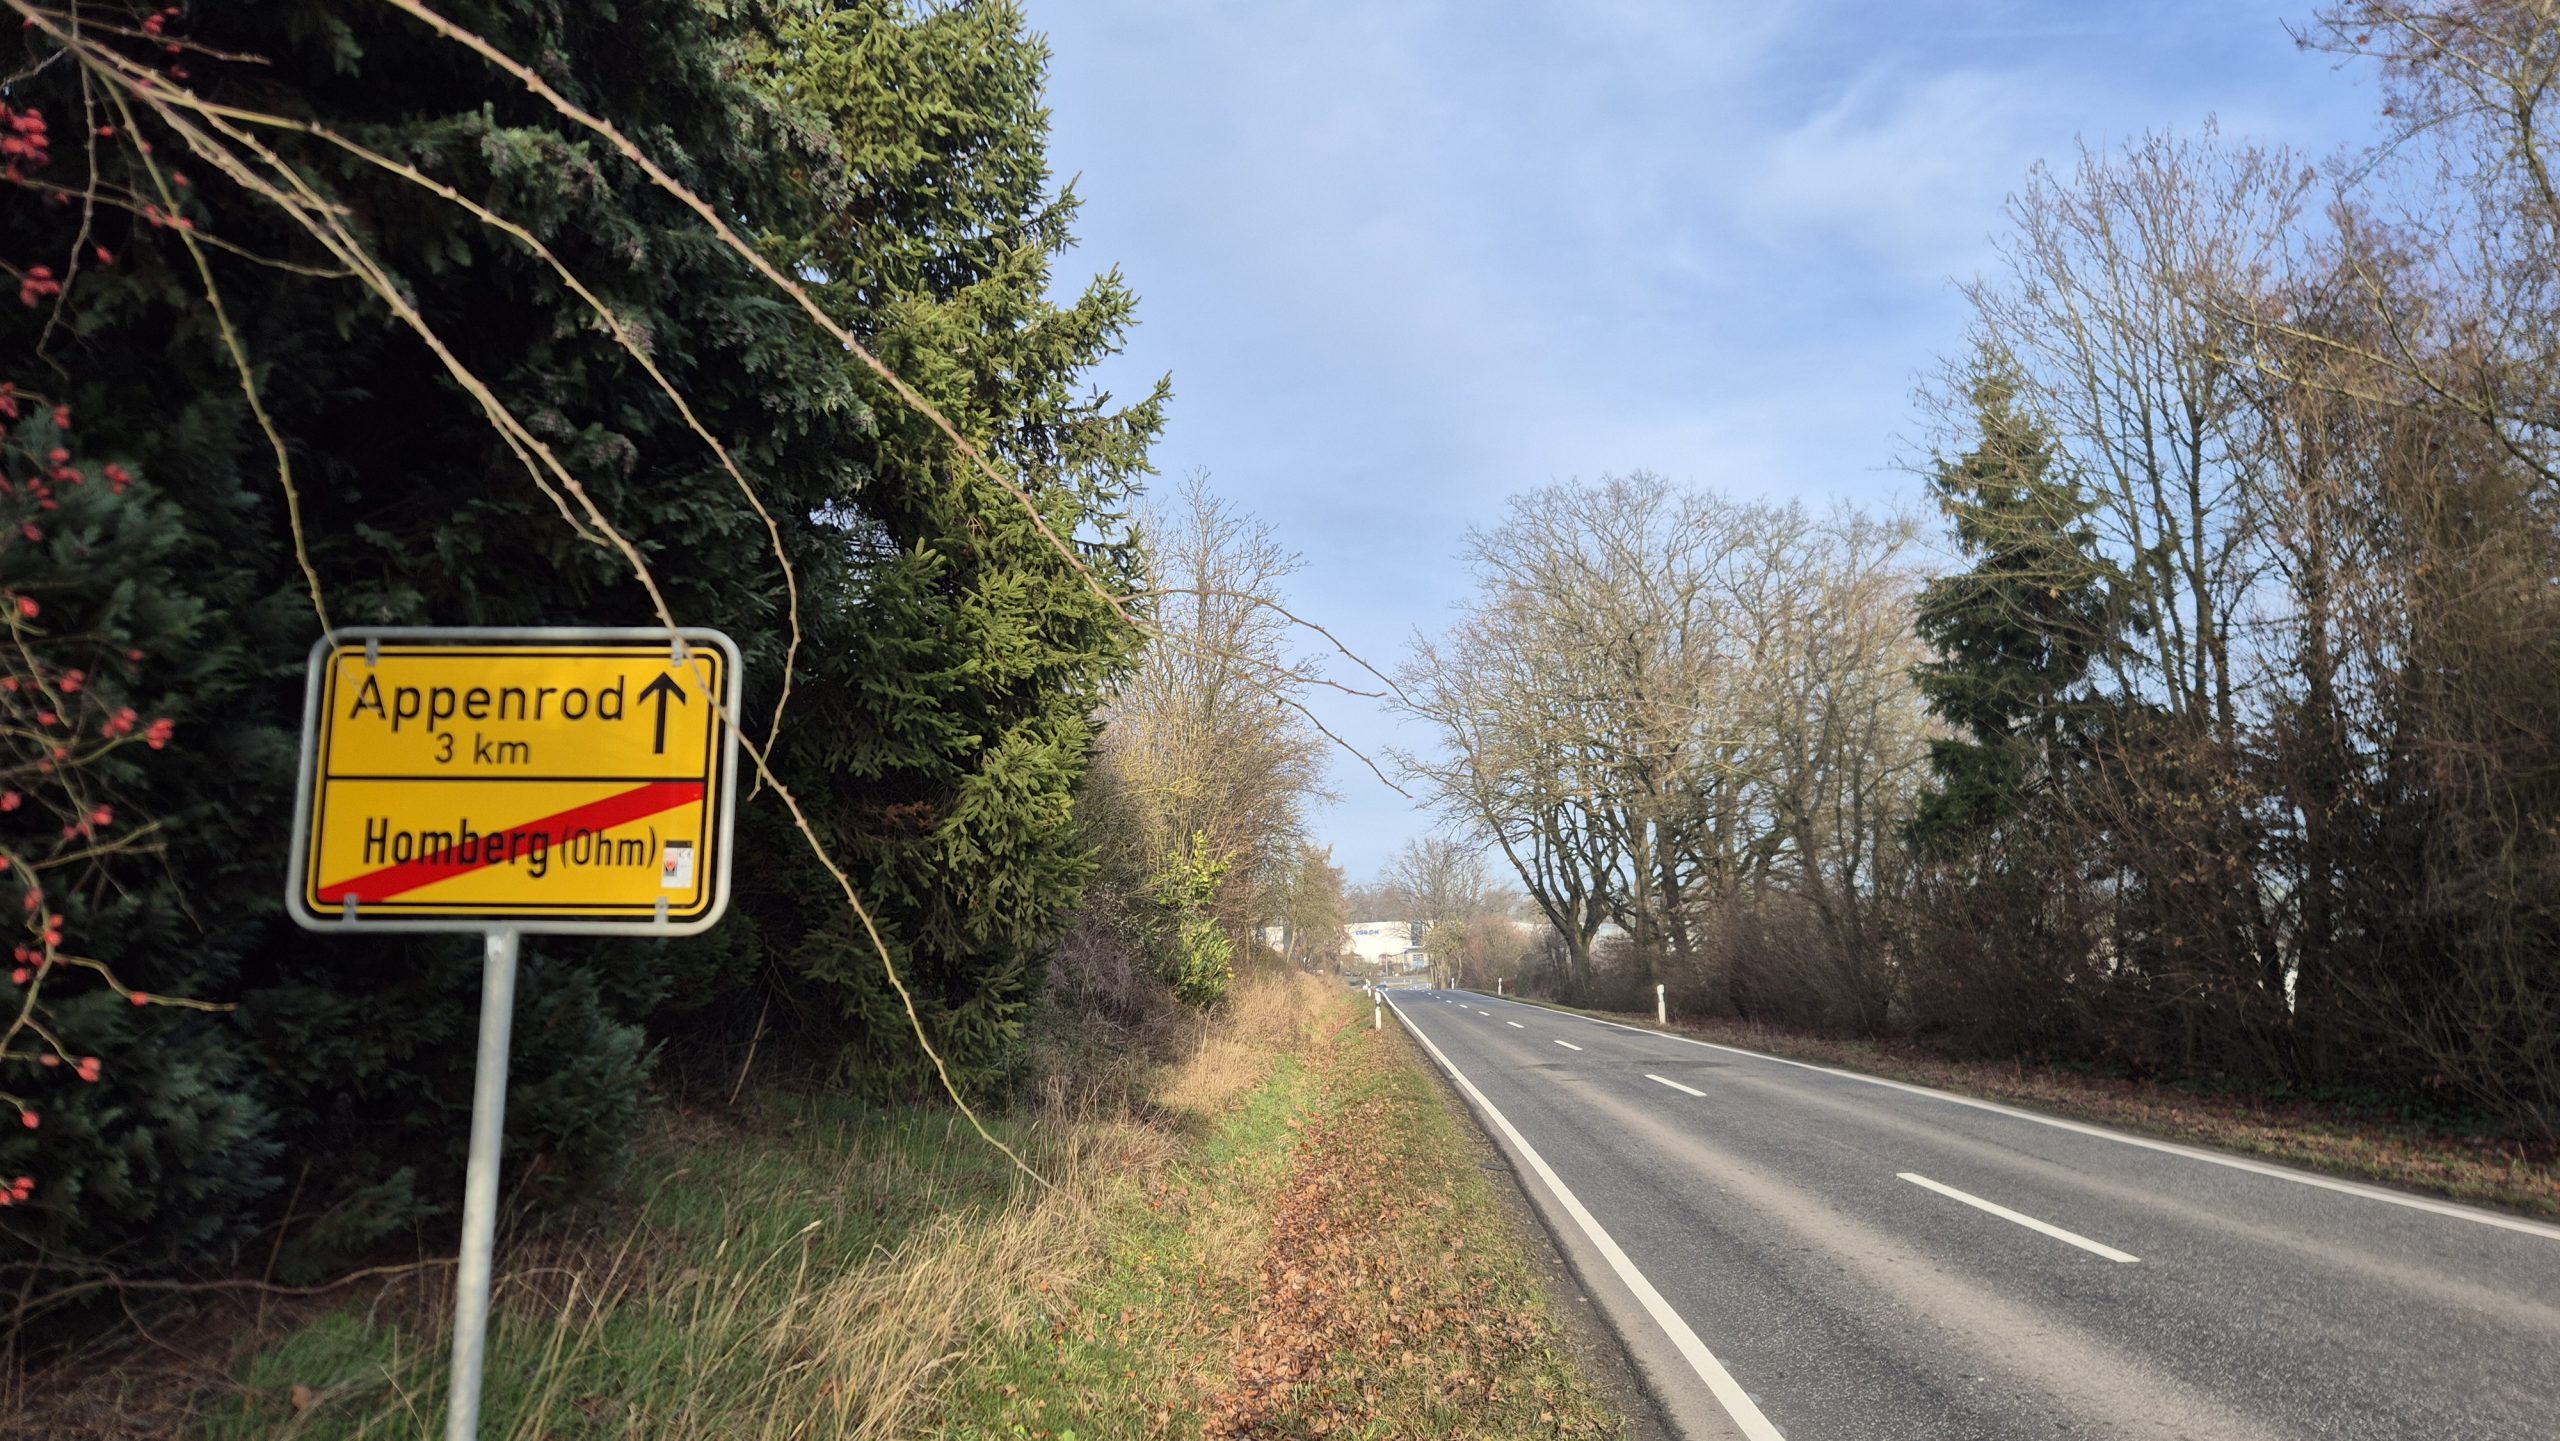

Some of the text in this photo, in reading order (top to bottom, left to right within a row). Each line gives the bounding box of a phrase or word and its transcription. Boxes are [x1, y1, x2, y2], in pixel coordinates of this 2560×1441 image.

[350, 674, 625, 734] Appenrod
[434, 733, 529, 764] 3 km
[363, 818, 656, 879] Homberg (Ohm)
